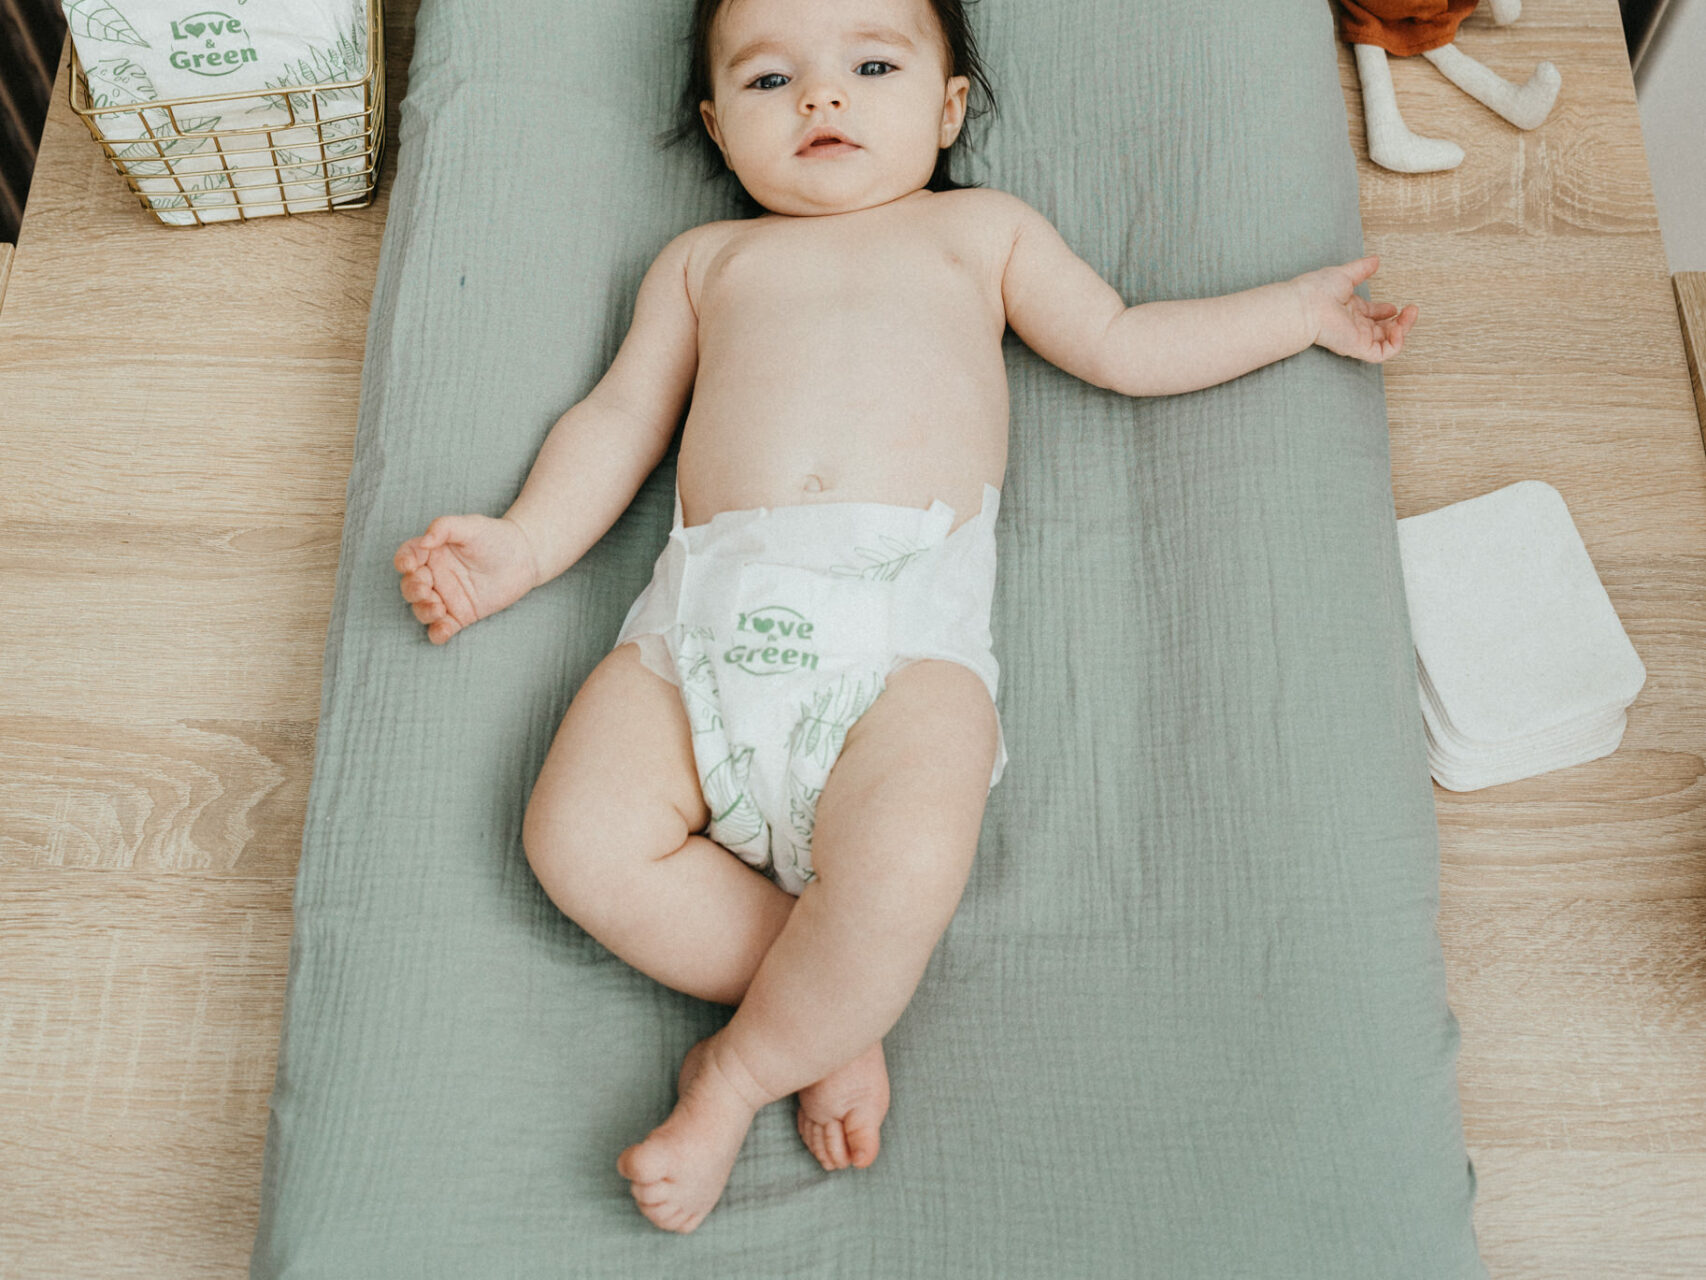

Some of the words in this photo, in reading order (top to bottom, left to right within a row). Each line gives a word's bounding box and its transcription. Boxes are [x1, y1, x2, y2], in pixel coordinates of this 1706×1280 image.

[170, 19, 241, 40] Love
[205, 39, 215, 48] &
[169, 48, 258, 69] Green
[723, 646, 820, 671] Green
